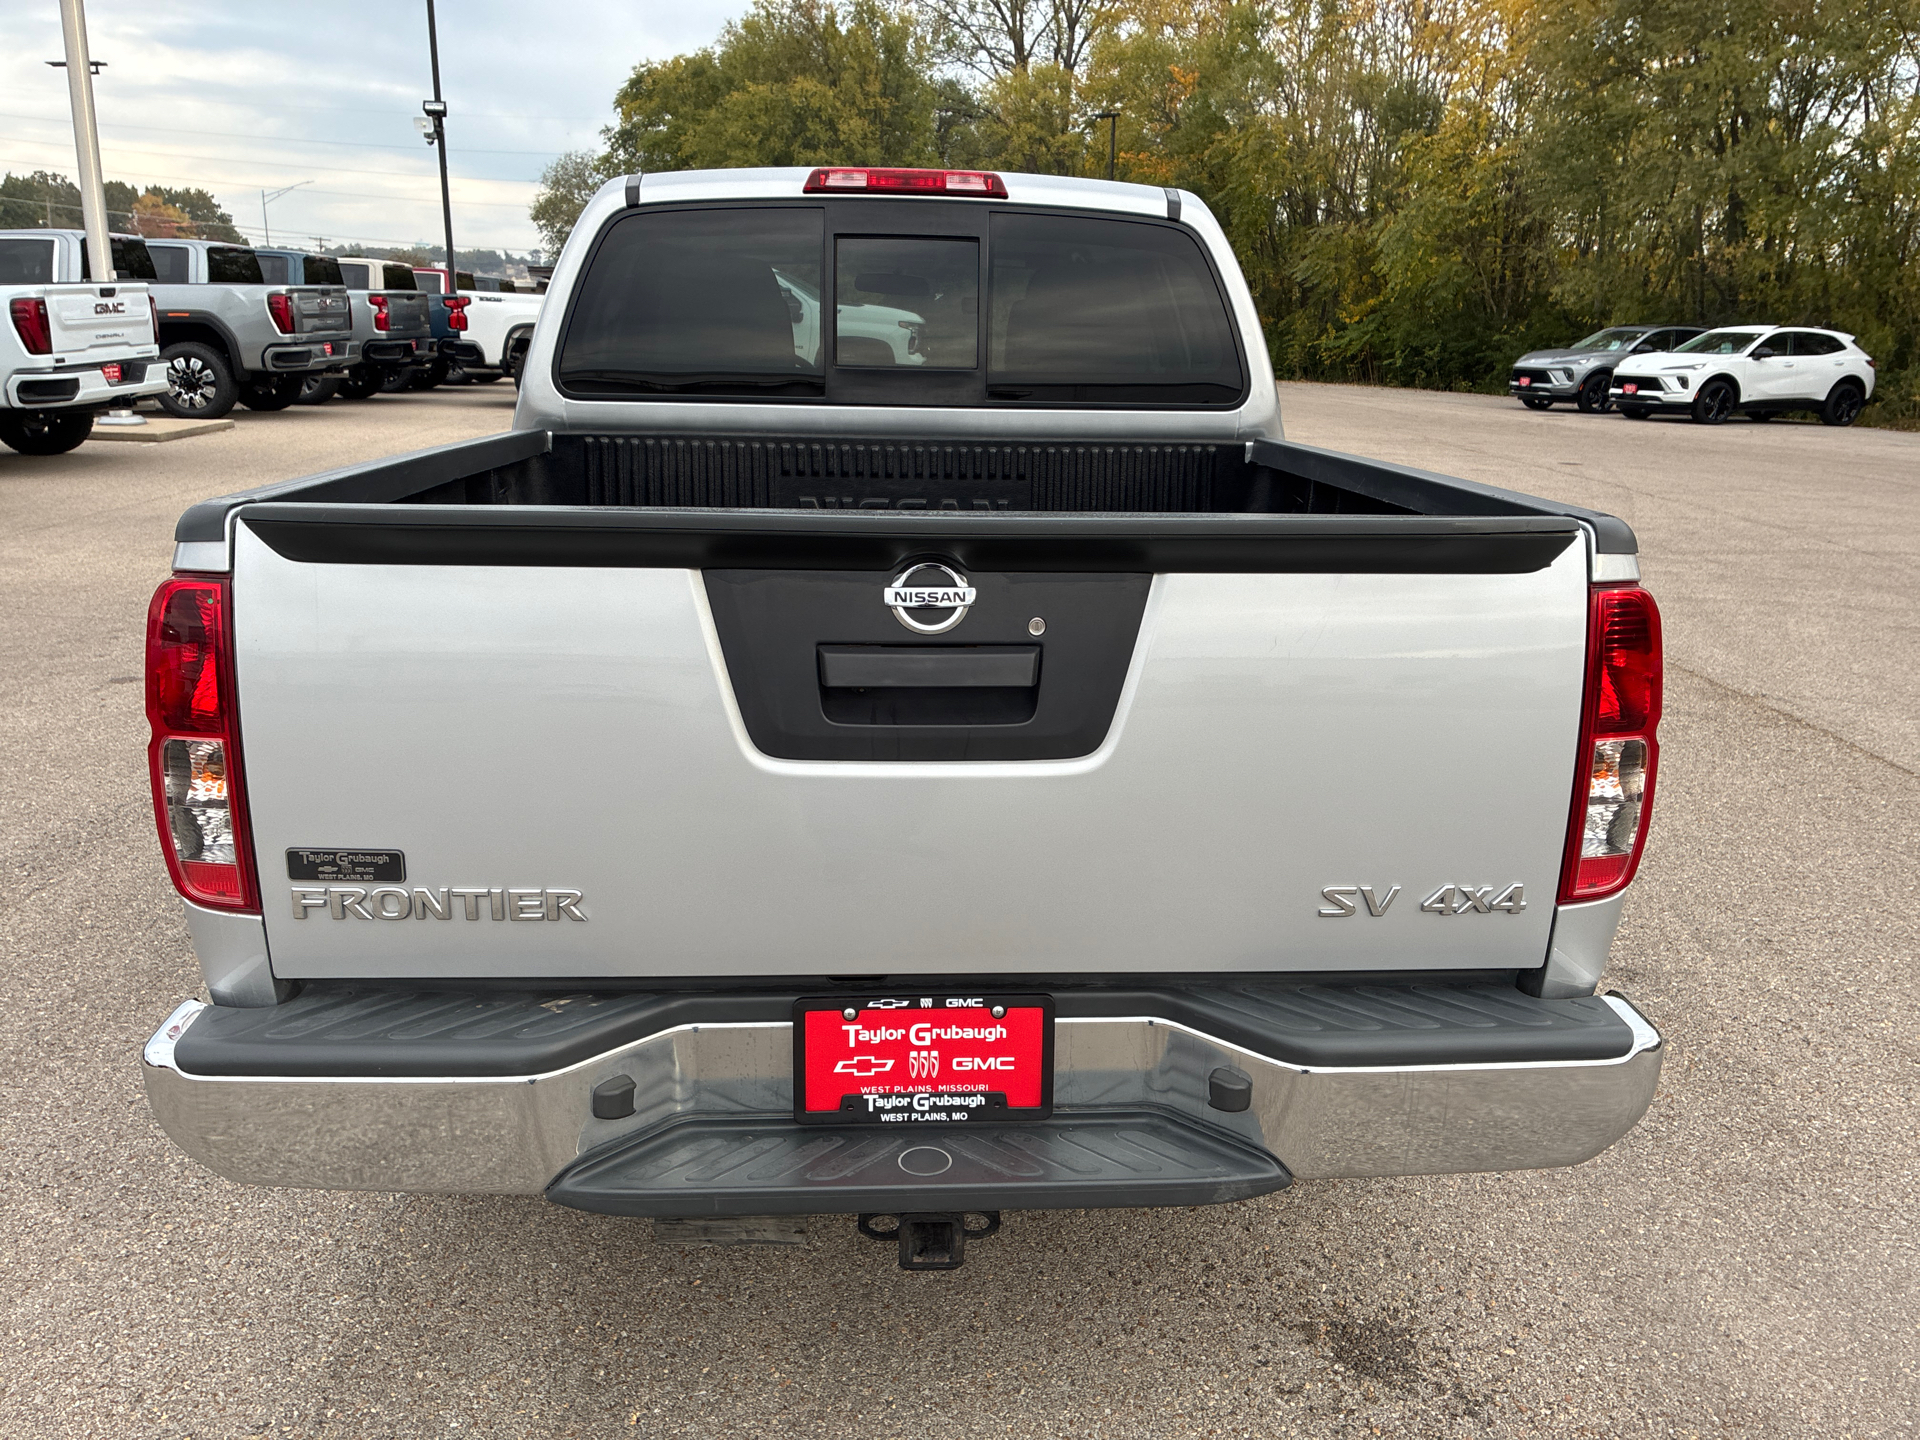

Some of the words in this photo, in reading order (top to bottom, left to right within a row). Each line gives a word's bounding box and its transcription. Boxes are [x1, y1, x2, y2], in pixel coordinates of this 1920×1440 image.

[94, 302, 126, 315] GMC
[894, 591, 966, 604] NISSAN
[299, 851, 334, 864] Taylor
[335, 852, 389, 865] Grubaugh
[291, 886, 589, 922] FRONTIER
[1318, 885, 1402, 917] SV
[945, 998, 984, 1008] GMC
[841, 1024, 906, 1048] Taylor
[909, 1023, 1007, 1046] Grubaugh
[952, 1056, 1015, 1071] GMC
[860, 1085, 891, 1094] WEST
[938, 1084, 989, 1093] MISSOURI
[863, 1094, 911, 1112] Taylor
[912, 1093, 986, 1111] Grubaugh
[880, 1113, 910, 1122] WEST
[911, 1112, 950, 1122] PLAINS,
[952, 1112, 968, 1121] MO
